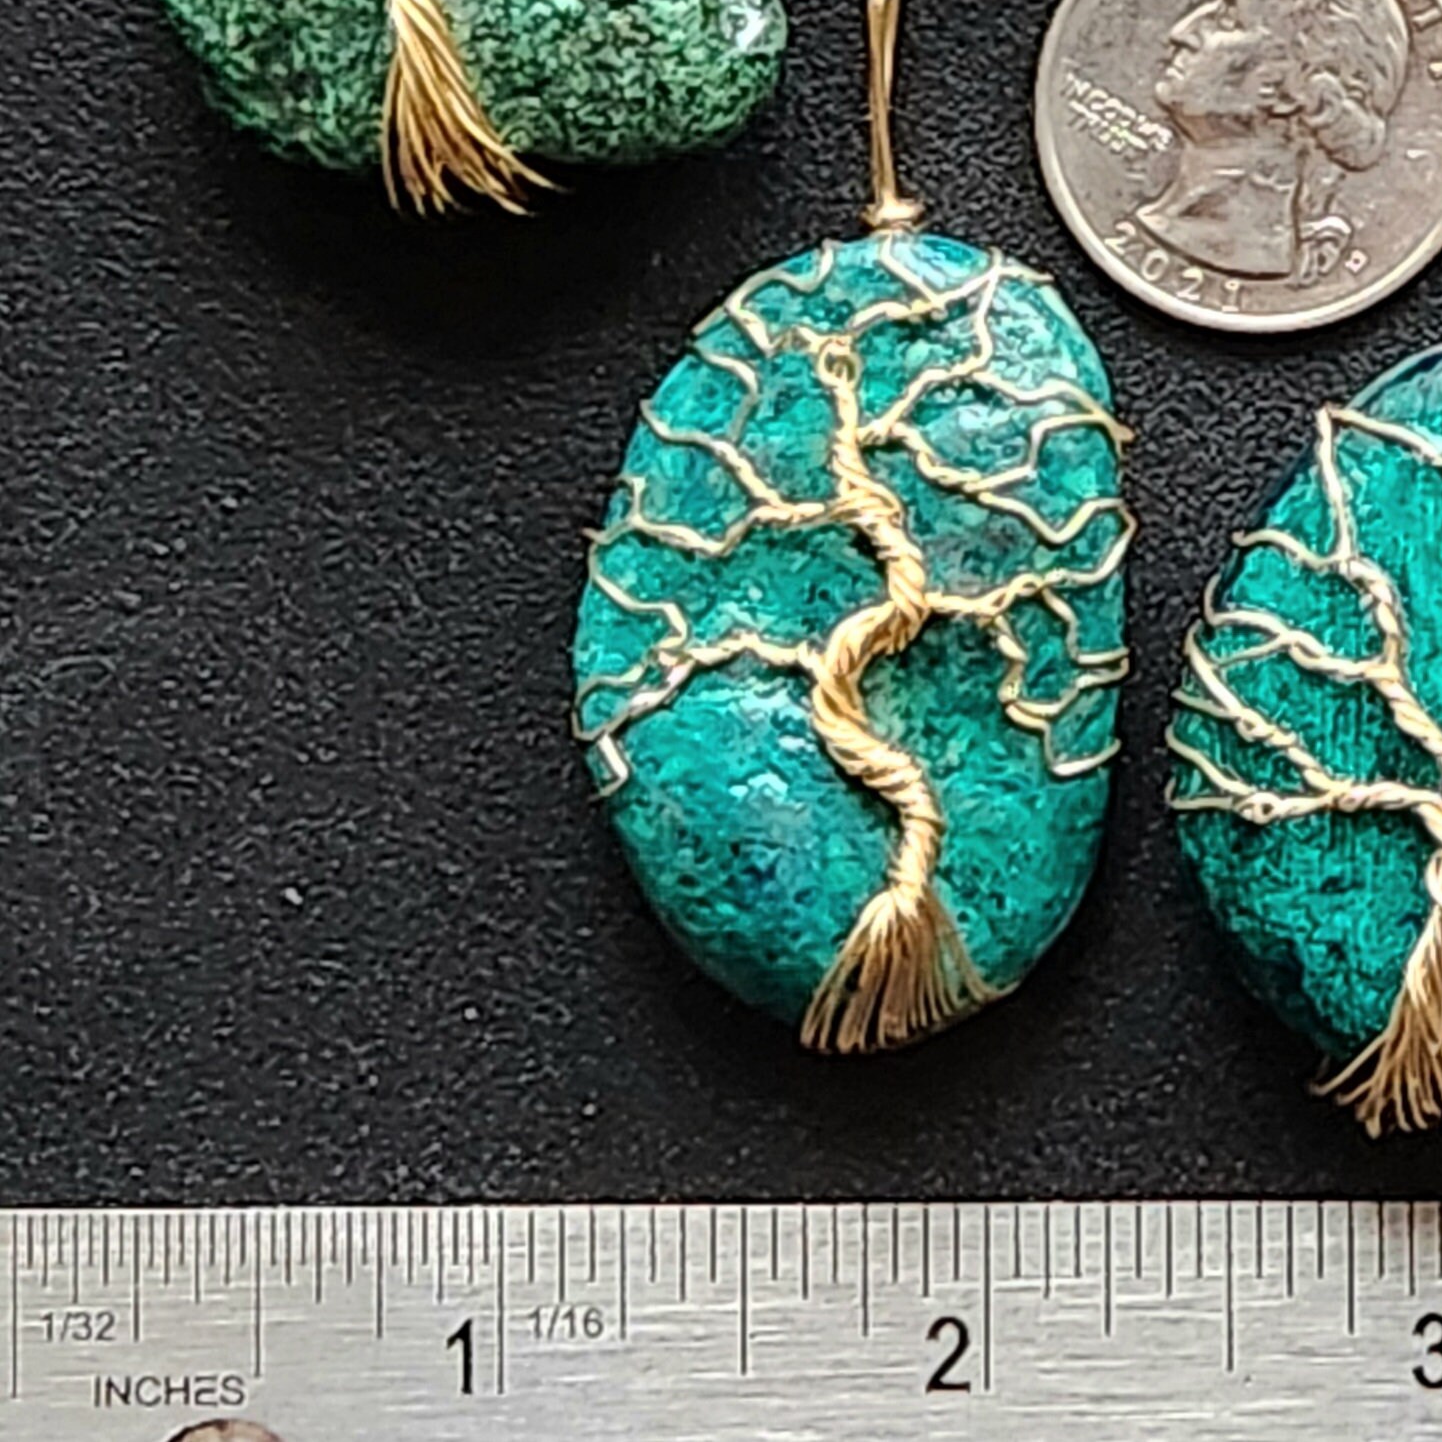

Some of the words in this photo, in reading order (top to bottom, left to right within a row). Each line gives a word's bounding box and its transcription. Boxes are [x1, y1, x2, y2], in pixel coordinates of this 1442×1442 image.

[1104, 221, 1244, 312] 2021
[40, 1312, 116, 1342] 1/32
[527, 1306, 603, 1339] 1/16
[445, 1318, 473, 1395] 1
[924, 1315, 971, 1392] 2
[93, 1374, 246, 1408] INCHES
